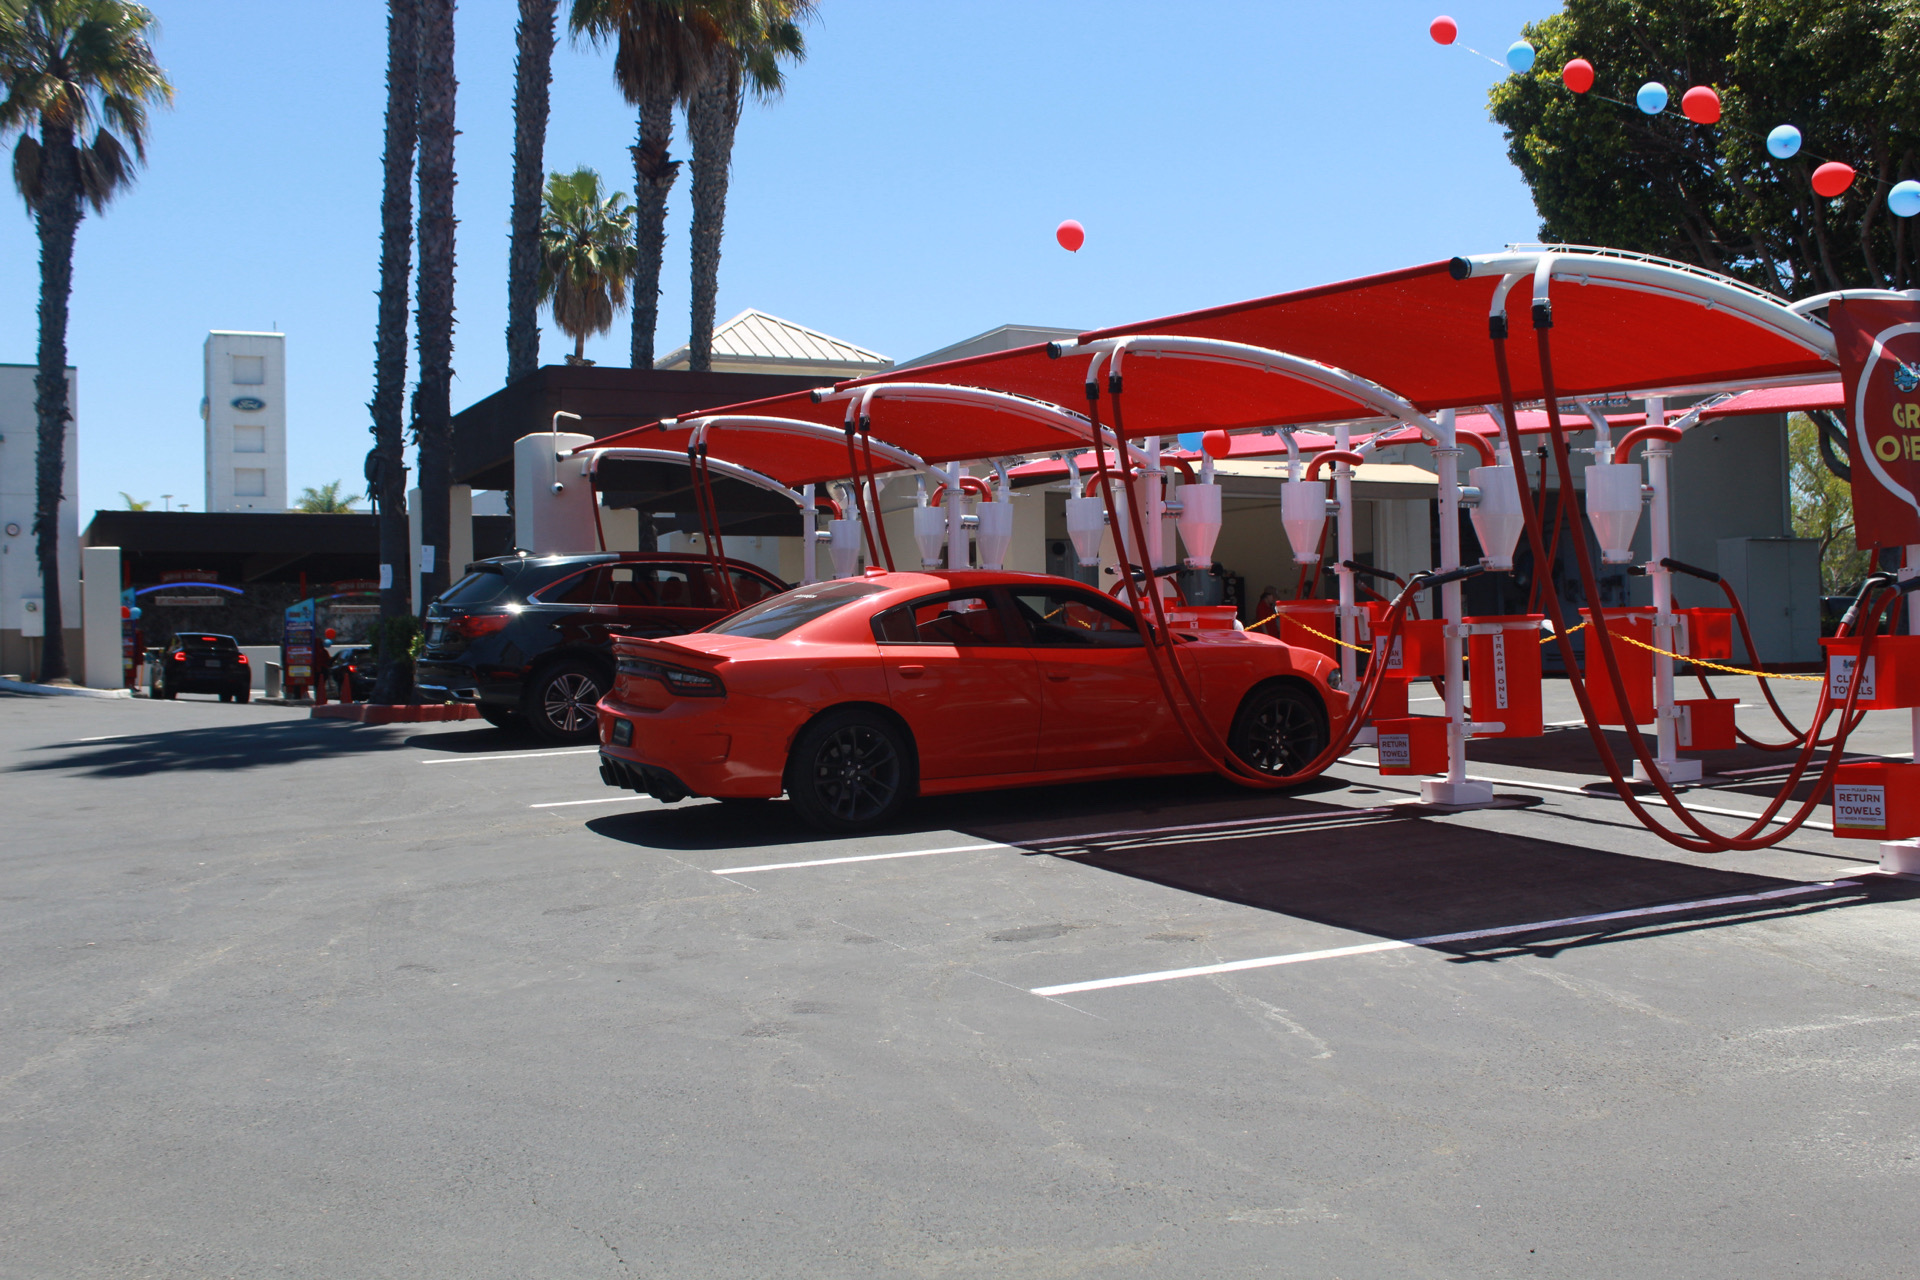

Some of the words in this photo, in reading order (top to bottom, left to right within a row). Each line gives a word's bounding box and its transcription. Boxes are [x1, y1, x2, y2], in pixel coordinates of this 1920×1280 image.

[1495, 635, 1504, 672] TRASH
[1836, 674, 1869, 684] CLN
[1497, 678, 1506, 707] ONLY
[1832, 685, 1873, 696] TOLS
[1381, 740, 1407, 748] RETURN
[1381, 750, 1408, 758] TOWELS
[1838, 793, 1881, 803] RETURN
[1838, 806, 1882, 816] TOWELS
